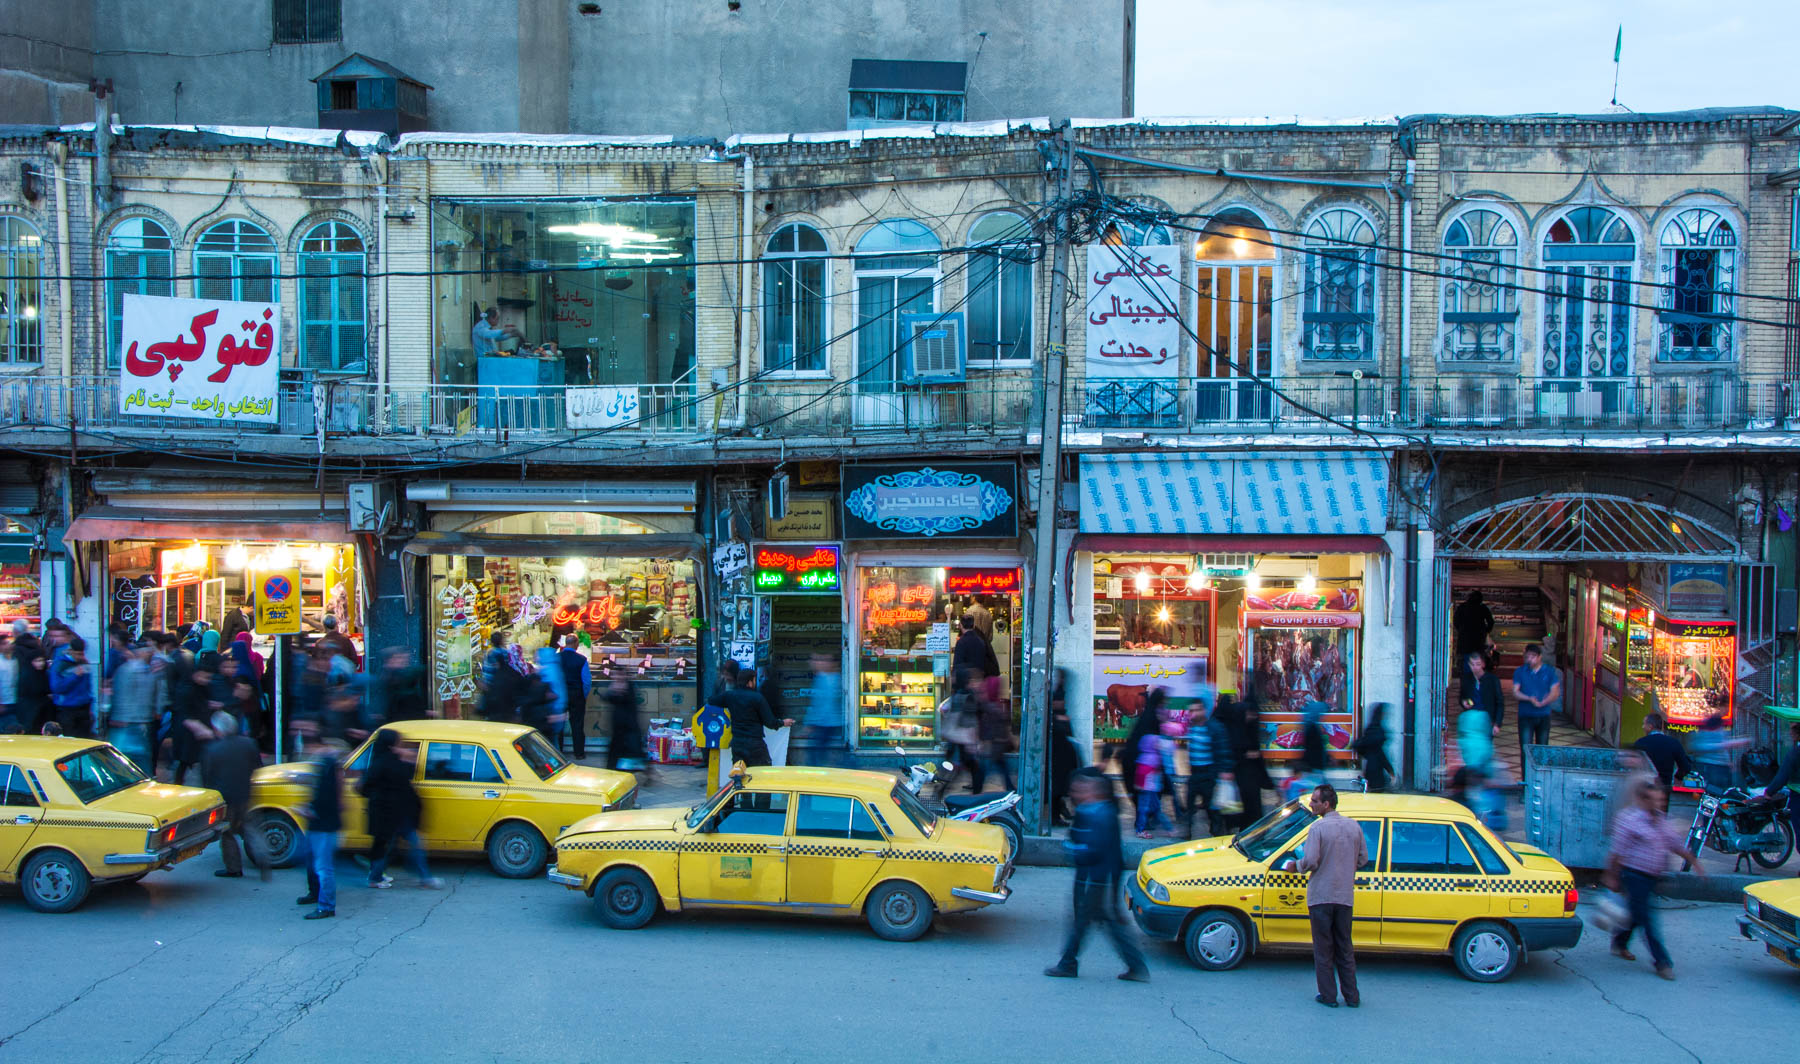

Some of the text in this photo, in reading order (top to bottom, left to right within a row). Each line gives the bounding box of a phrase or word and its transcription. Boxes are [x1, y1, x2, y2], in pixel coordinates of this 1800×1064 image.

[1093, 255, 1172, 286] عکاسی
[1099, 339, 1168, 365] وحدت
[191, 394, 225, 418] واحد
[228, 396, 273, 417] انتخاب
[606, 390, 638, 420] خیاطی
[878, 492, 980, 511] چای دستچین
[758, 548, 836, 572] عکاسی وحدت
[902, 585, 934, 606] چای
[589, 594, 624, 631] چای
[1103, 663, 1187, 678] خوش آمدید
